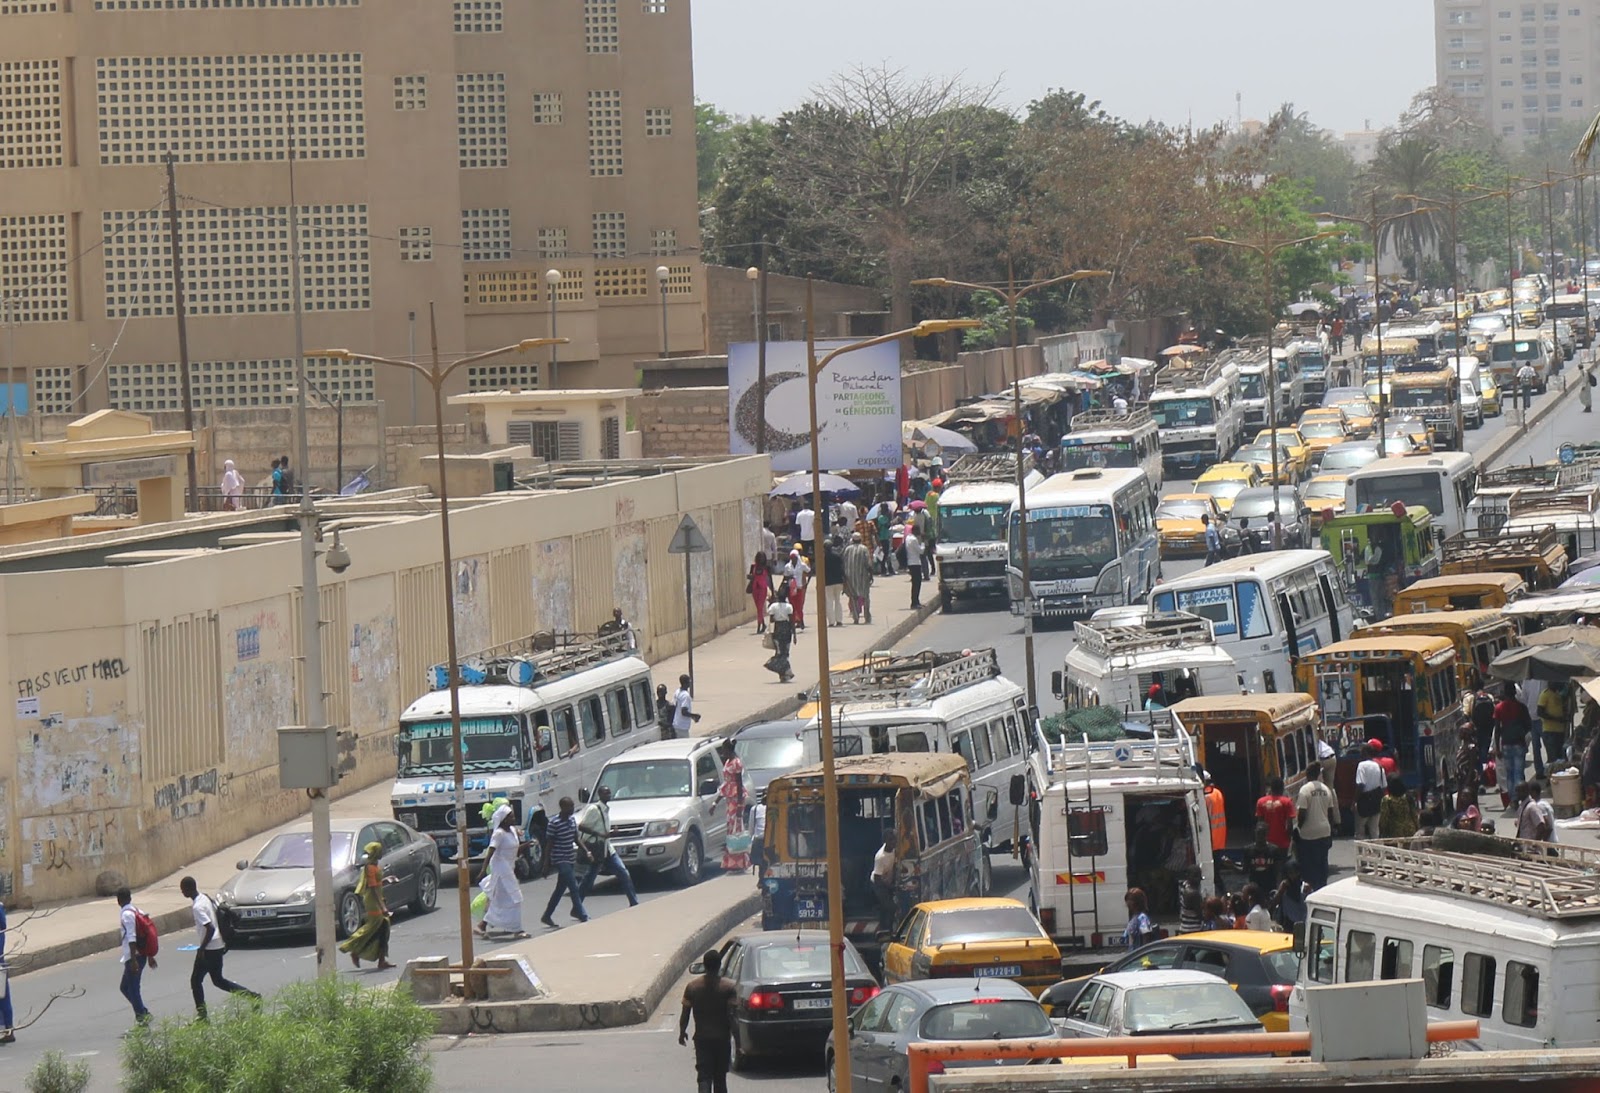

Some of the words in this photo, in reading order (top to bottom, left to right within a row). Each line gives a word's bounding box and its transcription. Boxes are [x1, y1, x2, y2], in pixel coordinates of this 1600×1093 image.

[832, 371, 894, 383] Ramadan
[833, 392, 886, 401] PARTAGEONS
[843, 404, 896, 416] GÉNÉROSITÉ
[857, 457, 897, 467] expresso
[18, 671, 51, 698] FASS
[54, 664, 88, 686] VEUT
[92, 658, 130, 680] MAEL
